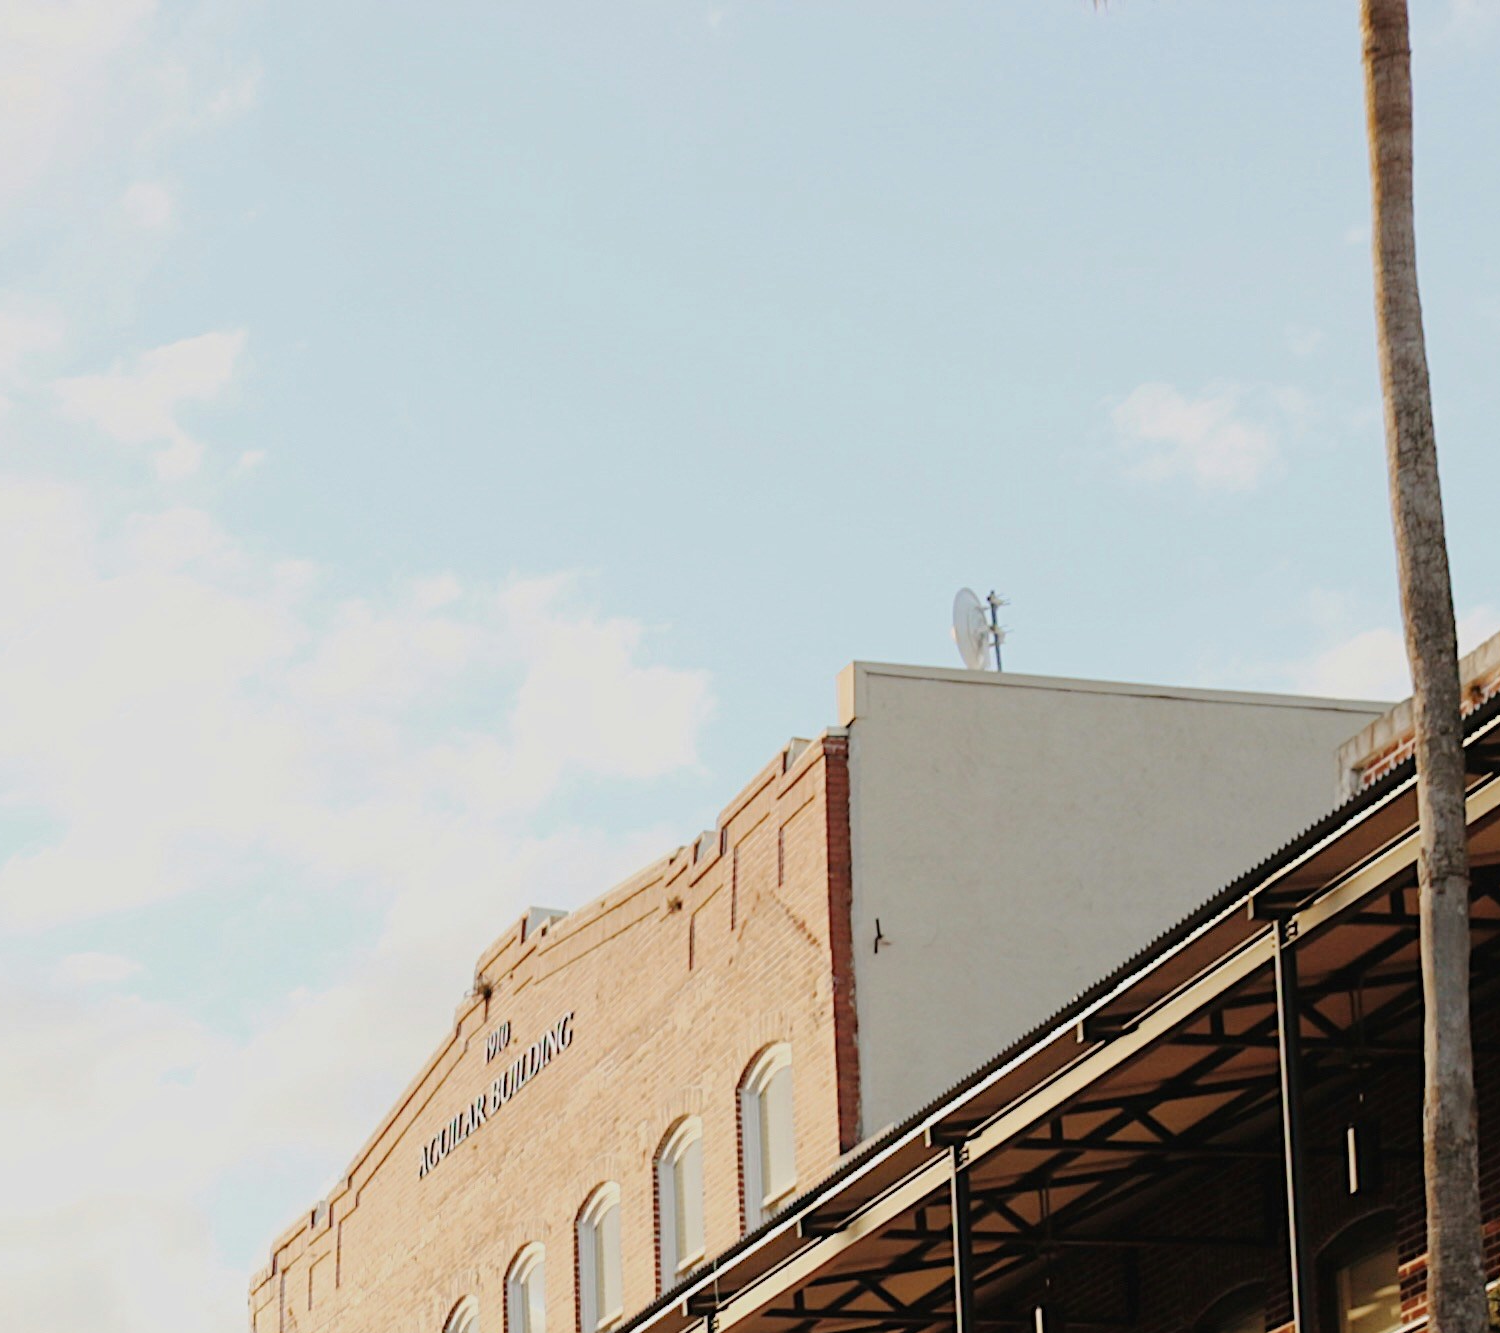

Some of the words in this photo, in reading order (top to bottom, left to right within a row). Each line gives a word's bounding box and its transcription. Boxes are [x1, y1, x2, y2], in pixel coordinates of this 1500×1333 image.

[419, 1093, 488, 1180] AGUILAR
[490, 1010, 576, 1118] BUILDING
[484, 1020, 511, 1065] 1910
